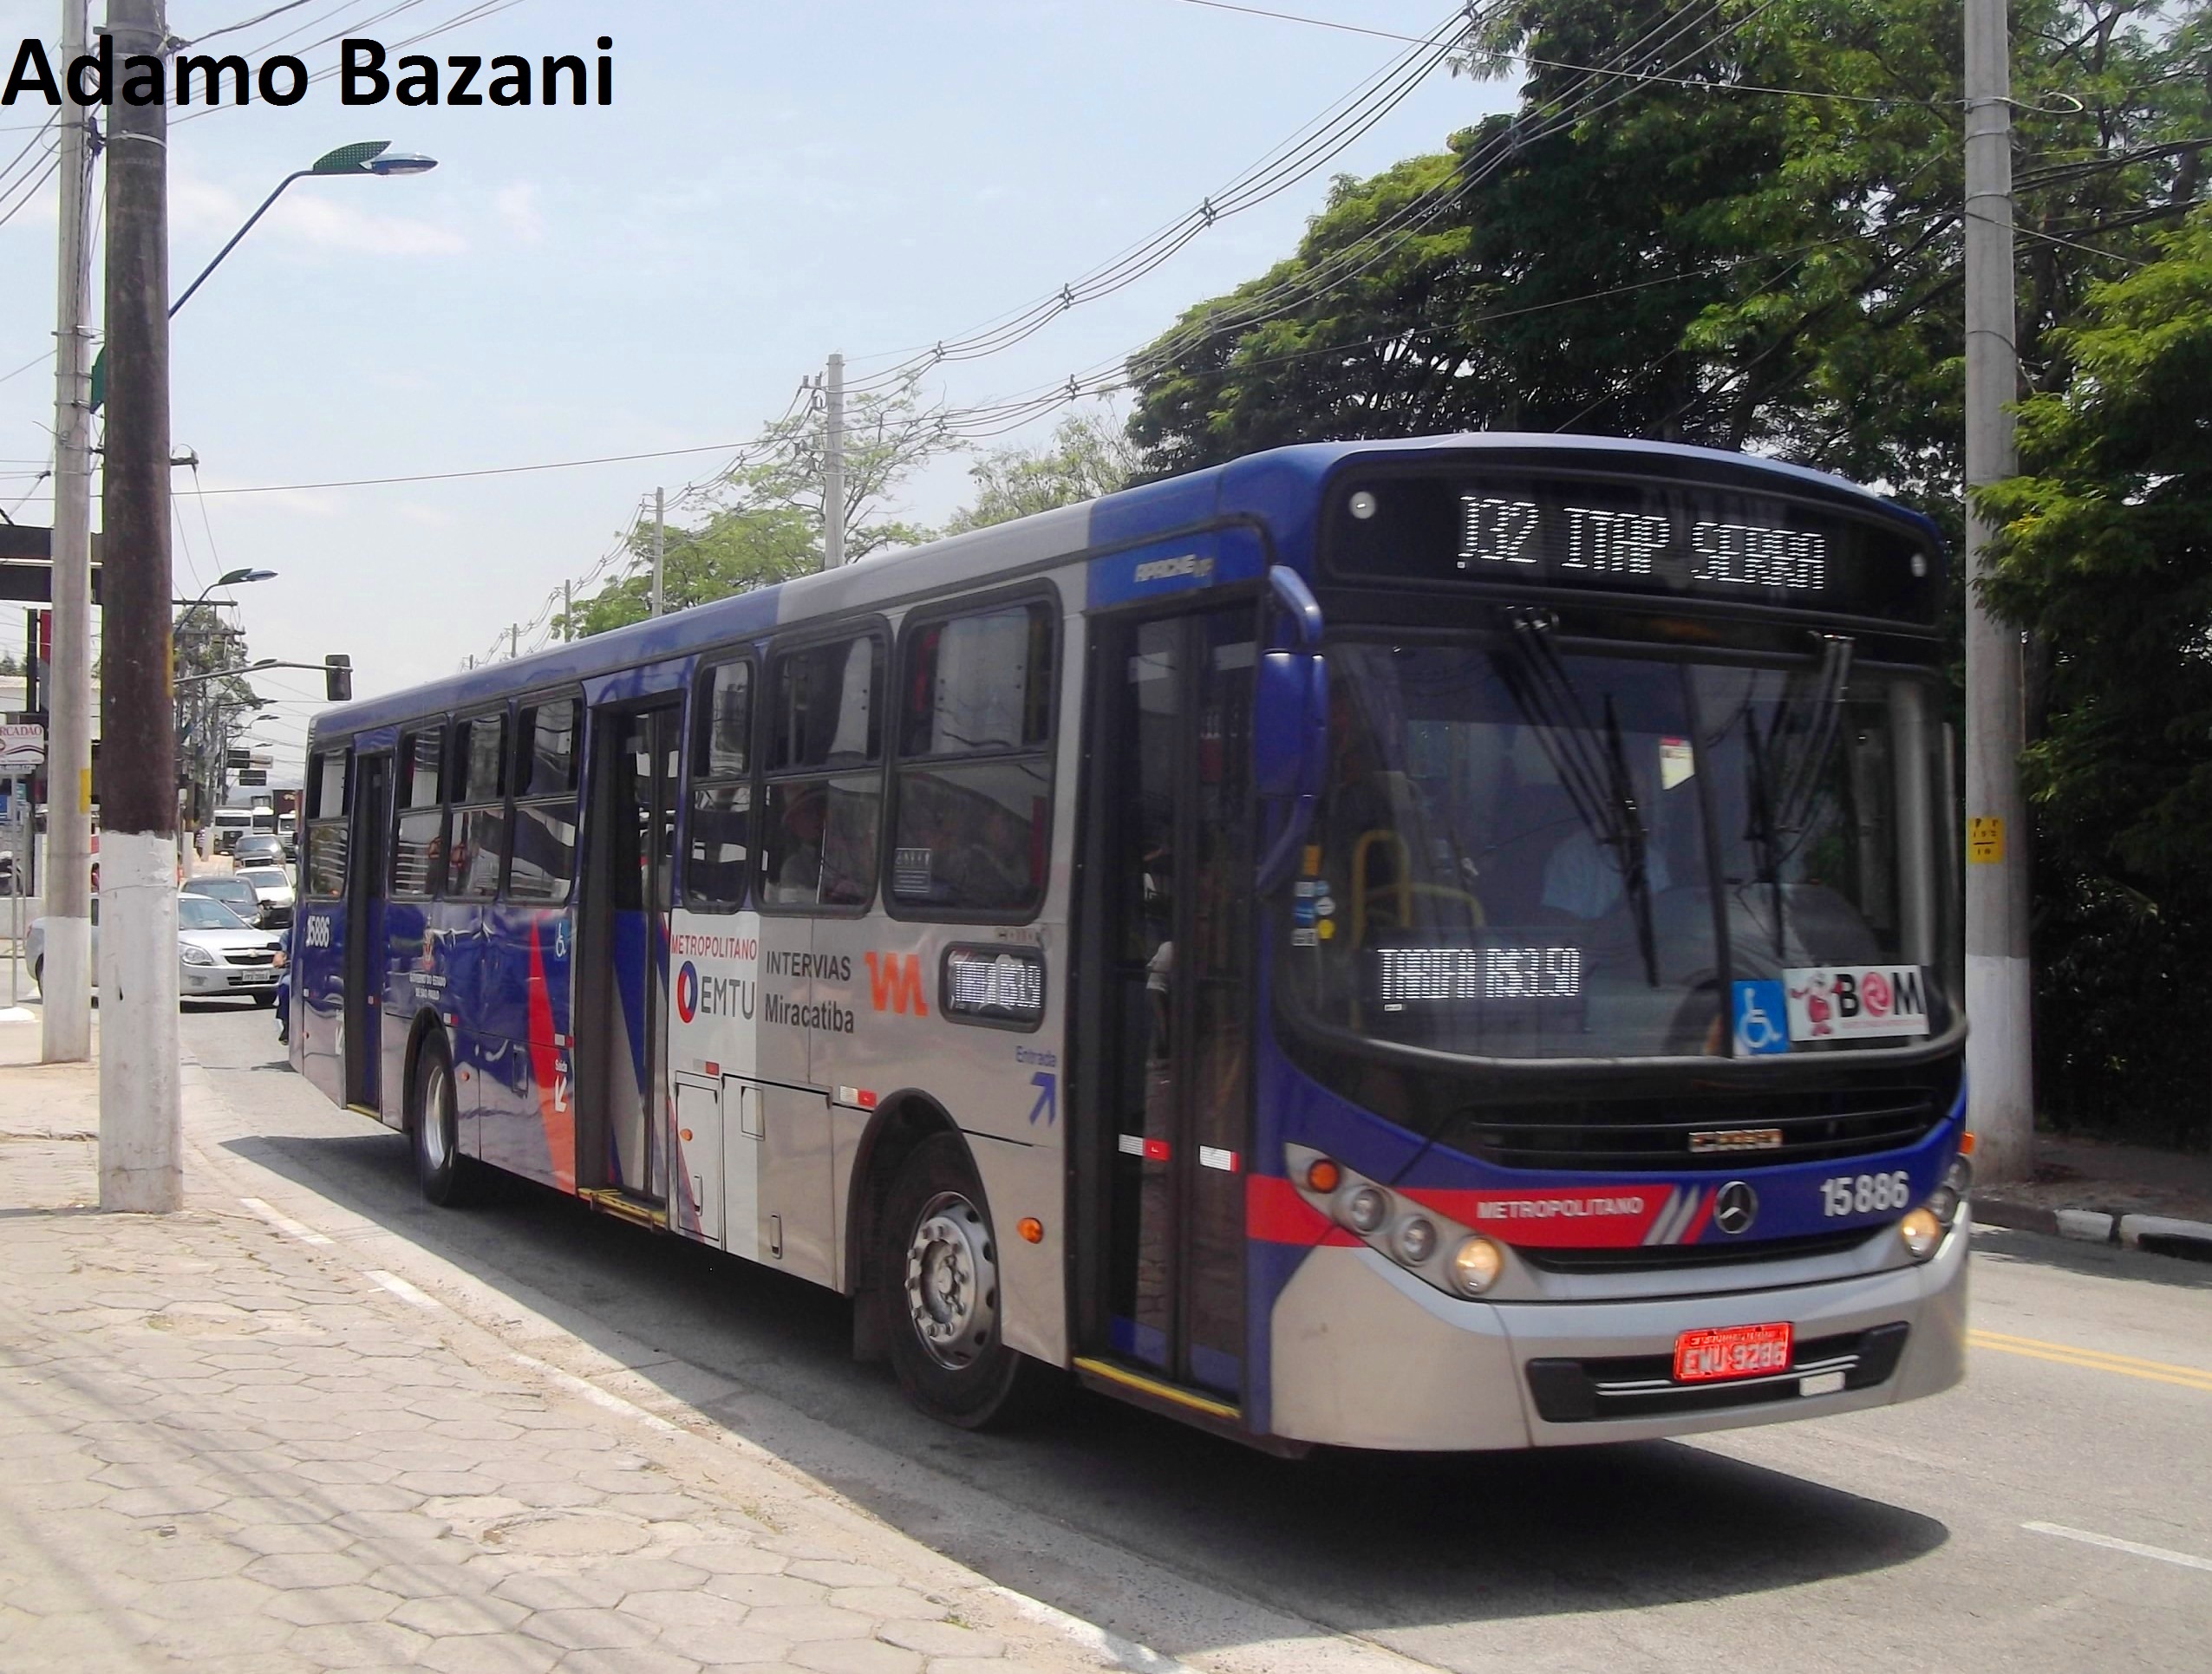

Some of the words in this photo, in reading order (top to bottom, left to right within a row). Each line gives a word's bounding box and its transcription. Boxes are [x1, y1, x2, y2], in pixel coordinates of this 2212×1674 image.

[1455, 496, 1540, 563] 132
[1562, 507, 1672, 575] ITAP
[1690, 520, 1826, 590] SERRA
[305, 915, 331, 948] 15886
[670, 935, 758, 961] METROPOLITANO
[766, 950, 852, 982] INTERVIAS
[700, 975, 756, 1020] EMTU
[765, 993, 855, 1034] Miracatiba
[1477, 1196, 1644, 1220] METROPOLITANO
[1820, 1170, 1910, 1217] 15886
